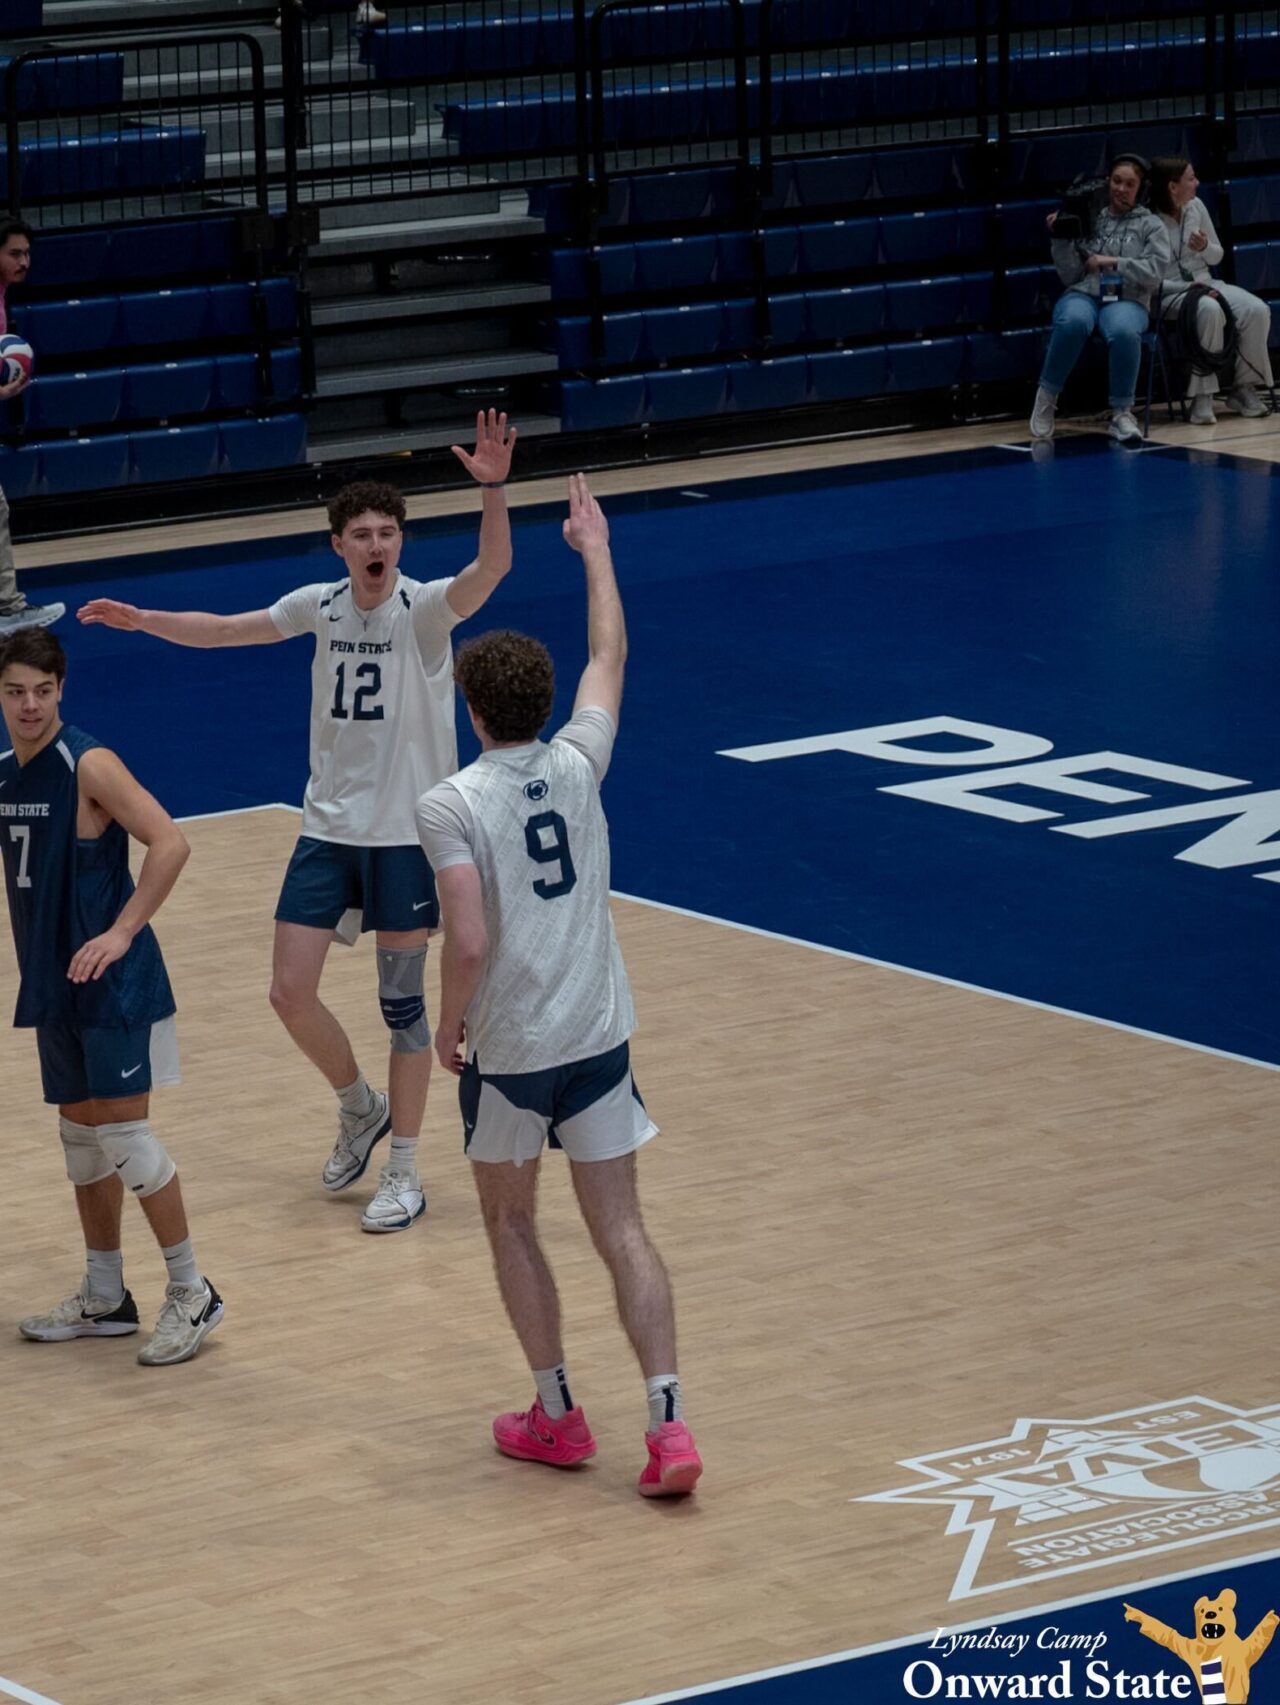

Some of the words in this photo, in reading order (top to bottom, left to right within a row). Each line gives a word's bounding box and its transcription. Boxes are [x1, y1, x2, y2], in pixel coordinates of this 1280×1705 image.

[331, 661, 384, 720] 12
[18, 803, 50, 817] STATE
[9, 825, 32, 888] 7
[525, 810, 577, 899] 9
[949, 1448, 1031, 1470] 1971
[995, 1424, 1264, 1486] EIVA
[1012, 1491, 1268, 1556] ASSOCIATION
